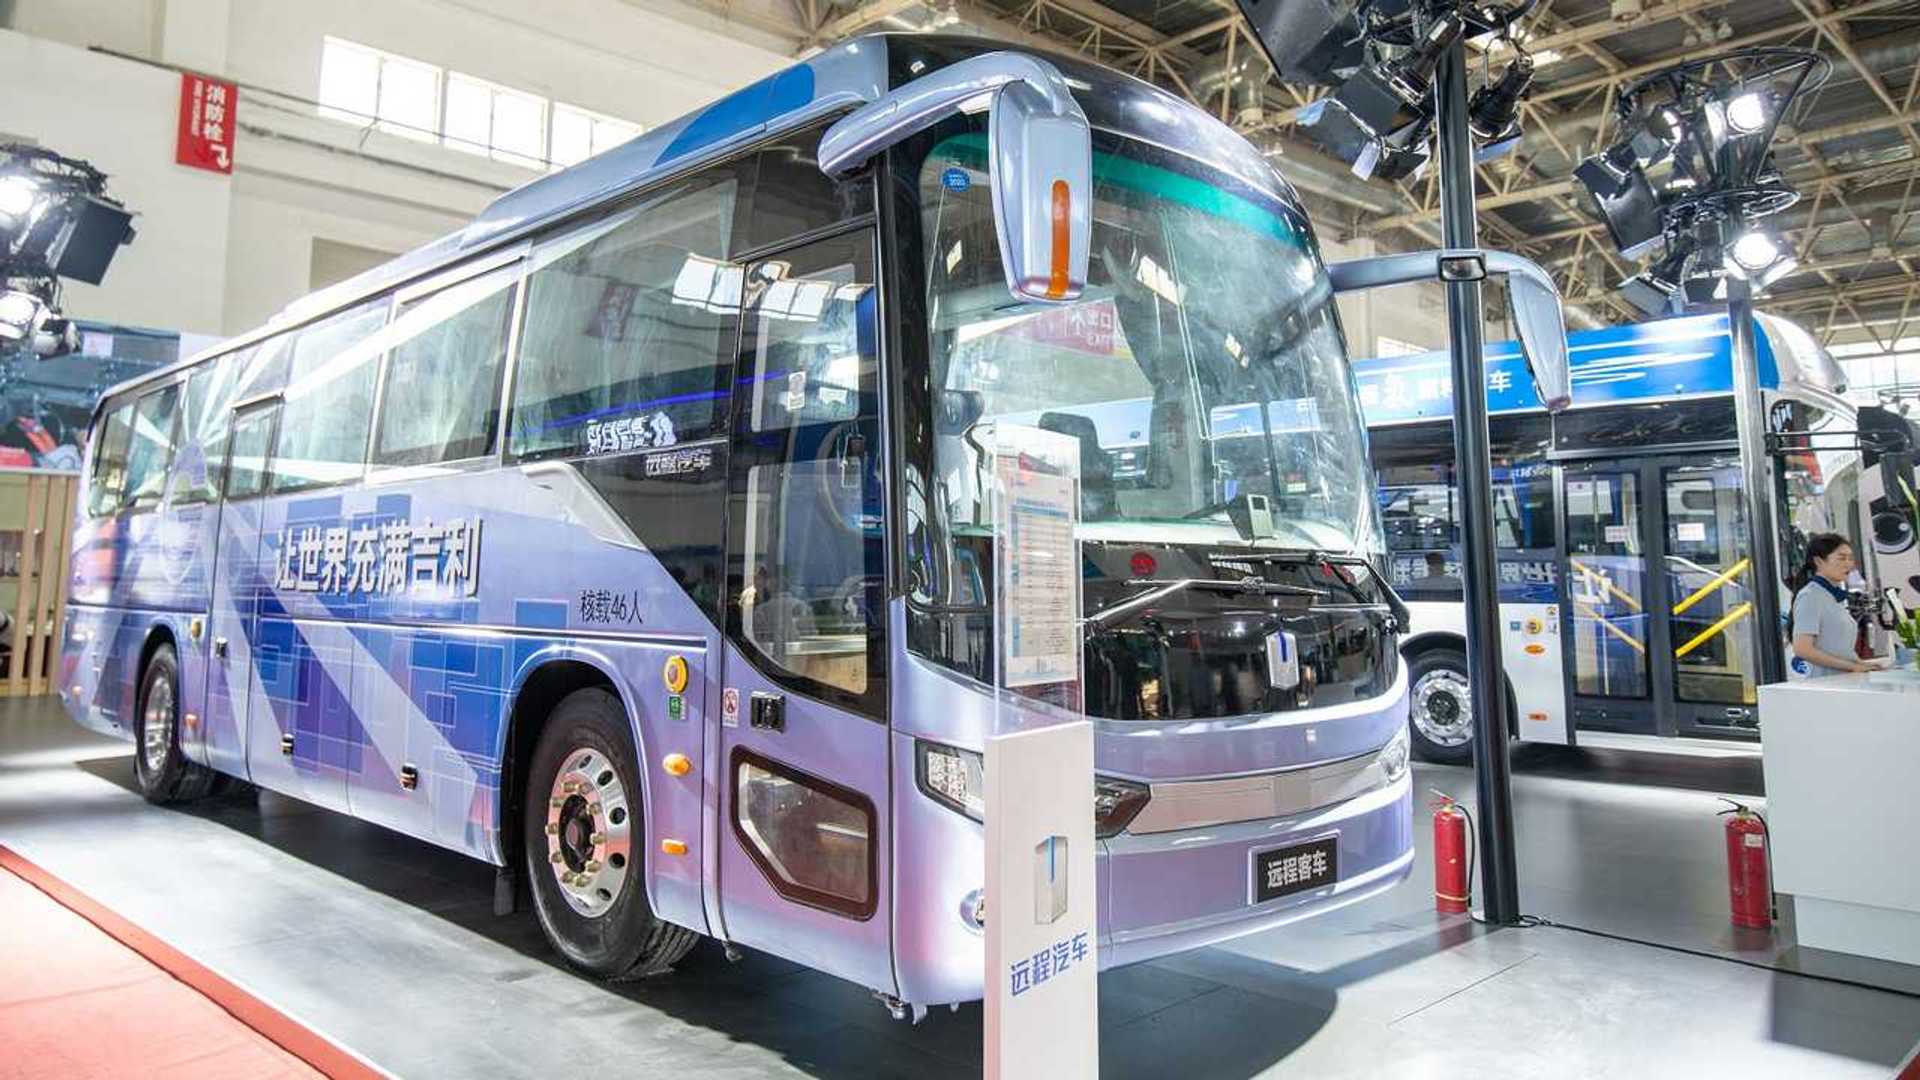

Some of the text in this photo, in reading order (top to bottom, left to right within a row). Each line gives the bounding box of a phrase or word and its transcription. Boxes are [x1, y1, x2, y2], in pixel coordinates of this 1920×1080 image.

[275, 515, 483, 599] 让世界充满吉利
[580, 589, 643, 624] 核载46人
[1267, 850, 1327, 888] 远程客车
[1010, 932, 1088, 997] 远程汽车
